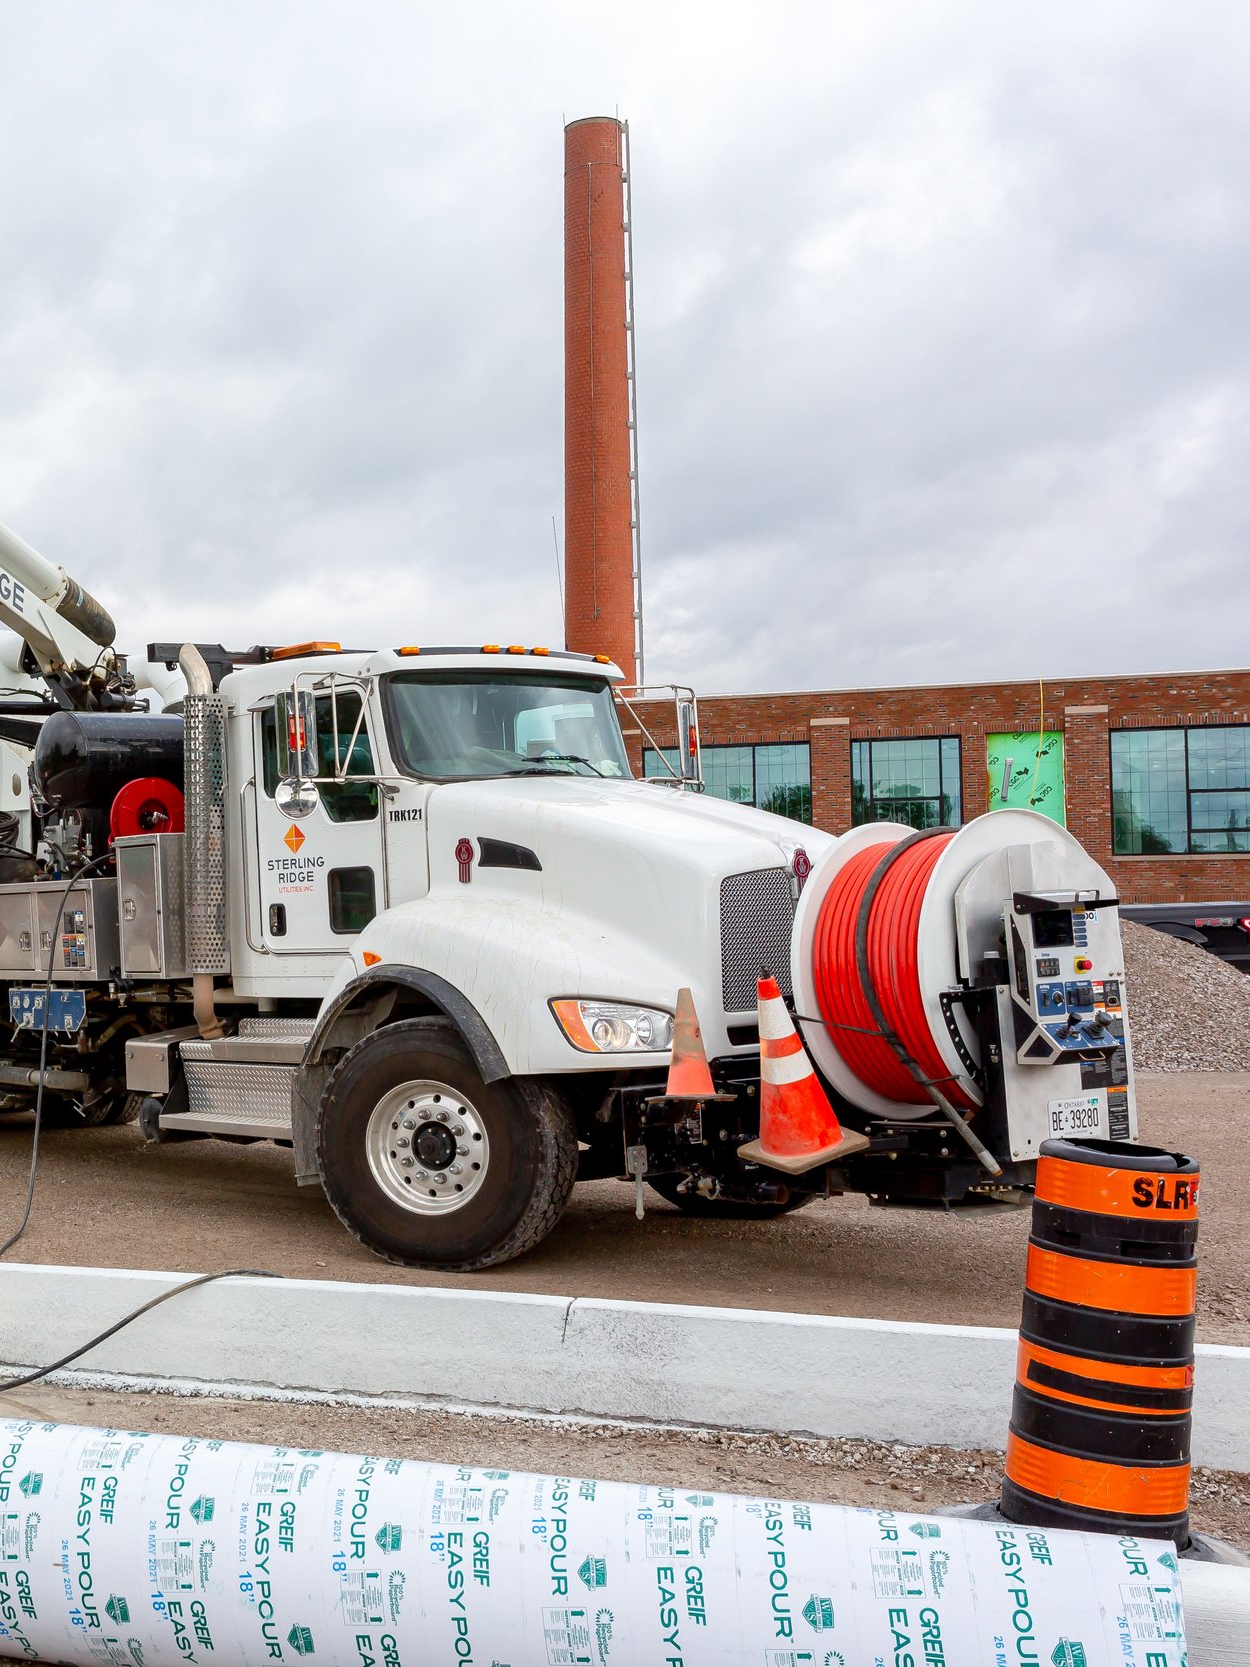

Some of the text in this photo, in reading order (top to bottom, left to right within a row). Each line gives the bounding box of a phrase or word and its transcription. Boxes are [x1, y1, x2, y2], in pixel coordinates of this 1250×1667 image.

[1045, 739, 1058, 750] CGC
[389, 809, 422, 821] TRK121
[1040, 786, 1052, 798] CGC
[268, 857, 325, 871] STERLING
[278, 871, 314, 883] RIDGE
[1052, 1108, 1098, 1131] BE 39280
[1064, 1101, 1084, 1109] ONTARIO
[1132, 1177, 1190, 1209] SLR
[100, 1476, 118, 1525] GREIF
[165, 1464, 188, 1529] POUR
[579, 1480, 597, 1501] GREIF
[279, 1502, 296, 1553] GREIF
[332, 1488, 348, 1582] 26 MAY 2021 18"
[350, 1490, 370, 1560] POUR
[431, 1505, 441, 1524] 2021
[532, 1495, 547, 1543] 2021 18"
[550, 1478, 570, 1596] EASY POUR
[638, 1507, 653, 1528] 18"
[764, 1502, 784, 1547] EASY
[792, 1505, 812, 1531] GREIF
[76, 1477, 101, 1628] EASY POUR
[148, 1520, 168, 1620] 26 MAY 2021 18"
[238, 1502, 255, 1602] 26 MAY 2021 18"
[430, 1532, 445, 1562] 18"
[473, 1531, 490, 1587] GREIF
[1026, 1532, 1052, 1566] GREIF
[61, 1540, 88, 1633] 26 MAY 2021 18"
[255, 1502, 283, 1659] EASY POUR
[448, 1532, 466, 1611] EASY
[930, 1561, 938, 1594] Paperboard
[936, 1561, 944, 1587] Recycled
[15, 1570, 38, 1620] GREIF
[657, 1567, 681, 1651] EASY
[685, 1566, 706, 1626] GREIF
[768, 1552, 793, 1638] POUR
[995, 1531, 1040, 1667] EASY POU
[167, 1601, 198, 1664] EASY
[190, 1600, 215, 1650] GREIF
[596, 1624, 605, 1661] Paperboard
[601, 1623, 610, 1654] Recycled
[994, 1636, 1004, 1649] 26
[1117, 1616, 1134, 1658] 26 MAY
